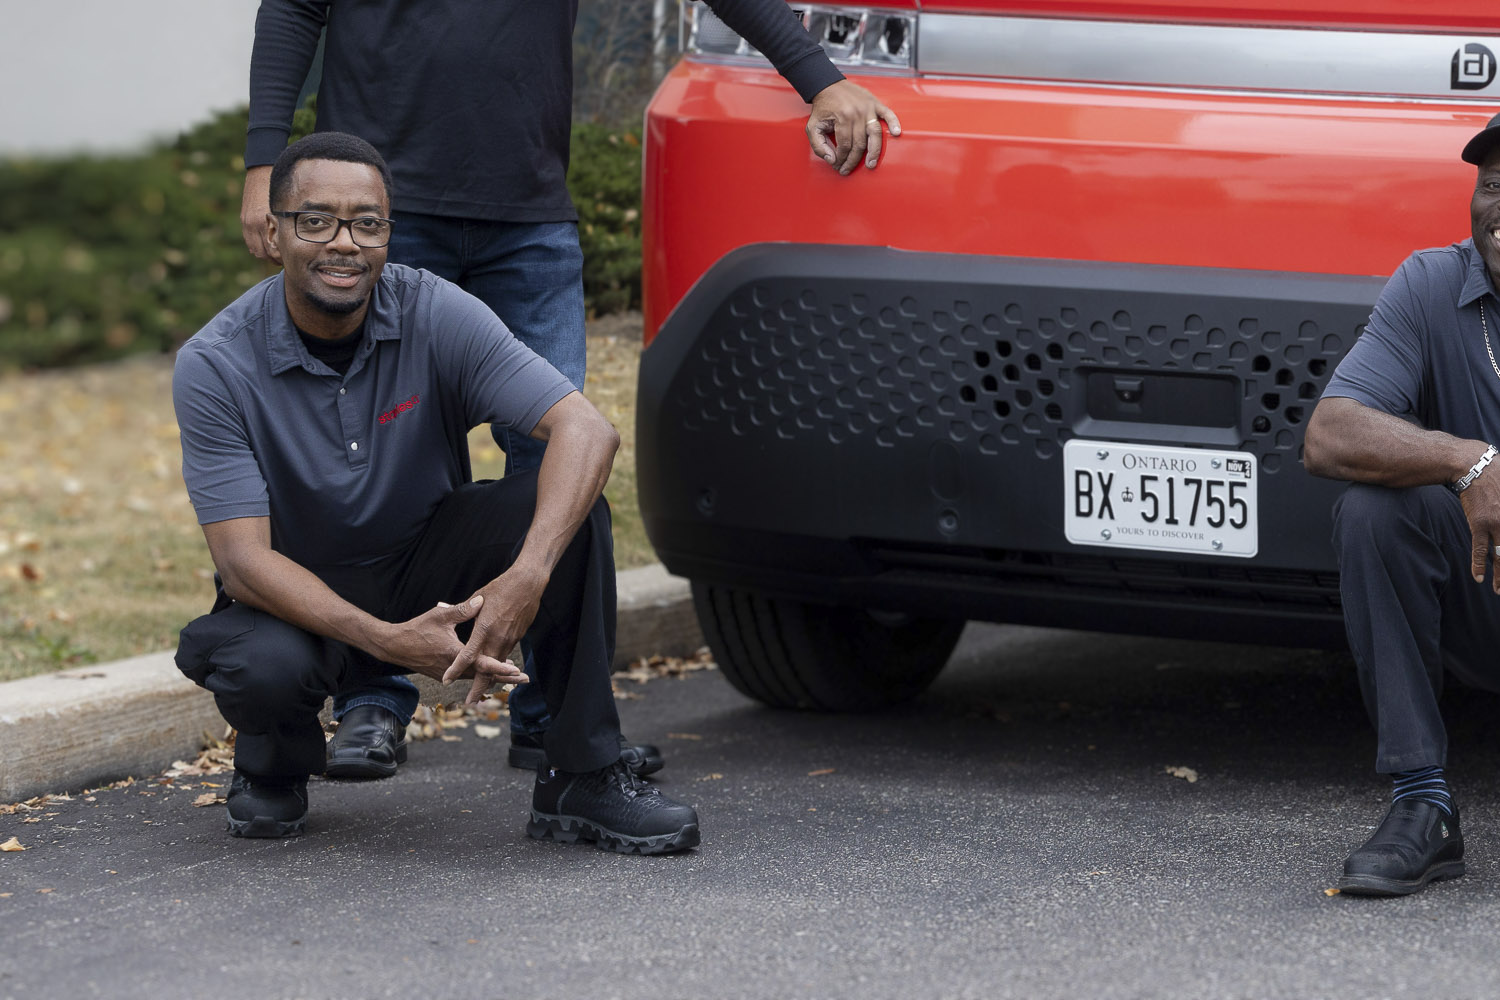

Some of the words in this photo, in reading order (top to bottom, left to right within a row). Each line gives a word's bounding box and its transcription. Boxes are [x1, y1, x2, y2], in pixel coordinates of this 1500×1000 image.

[1122, 453, 1197, 474] ONTARIO
[1116, 526, 1144, 536] YOURS
[1149, 529, 1159, 538] TO
[1162, 530, 1205, 541] DISCOVER
